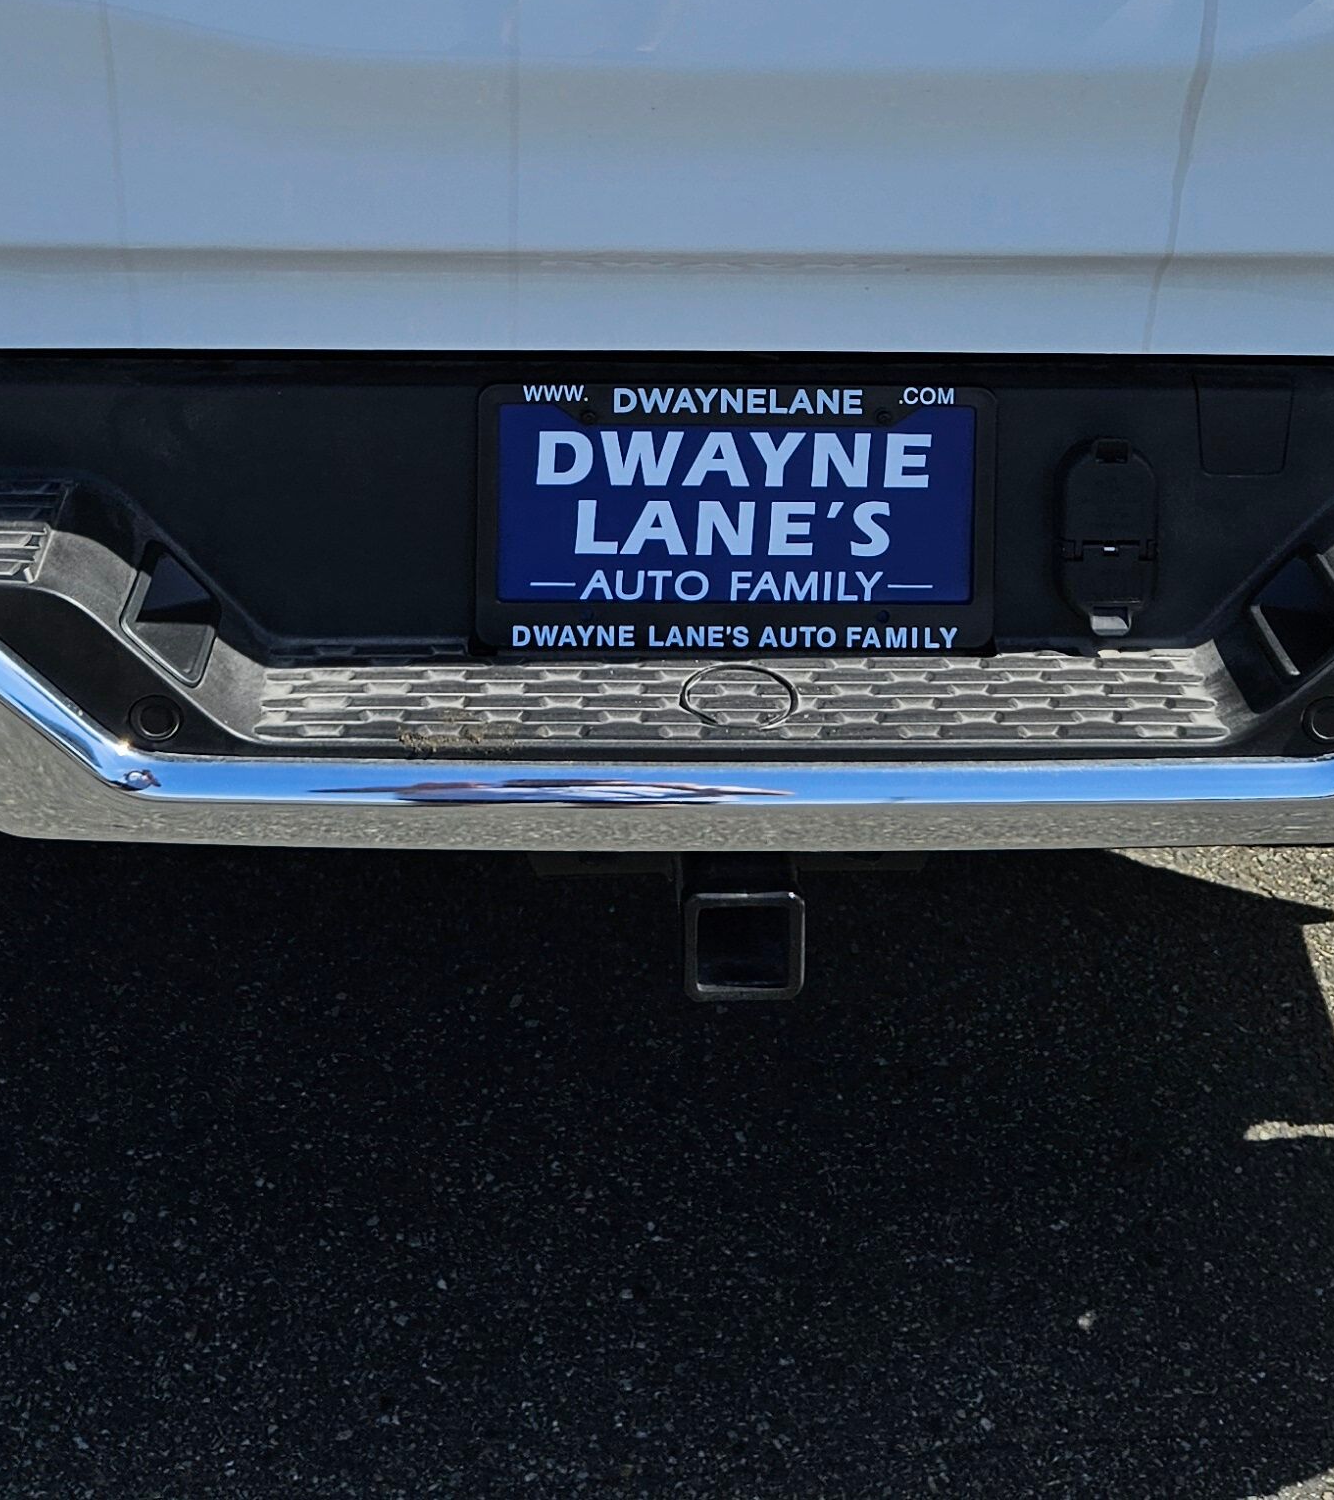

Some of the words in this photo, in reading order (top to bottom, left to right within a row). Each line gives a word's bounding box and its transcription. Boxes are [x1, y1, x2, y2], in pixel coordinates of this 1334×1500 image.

[612, 388, 863, 415] DWAYNELANE
[899, 387, 954, 405] .COM
[536, 431, 932, 488] DWAYNE
[574, 500, 890, 557] LANE'S
[580, 570, 709, 601] AUTO
[730, 571, 883, 602] FAMILY
[512, 625, 635, 648] DWAYNE
[649, 625, 749, 649] LANE'S
[759, 626, 836, 649] AUTO
[847, 626, 957, 650] FAMILY
